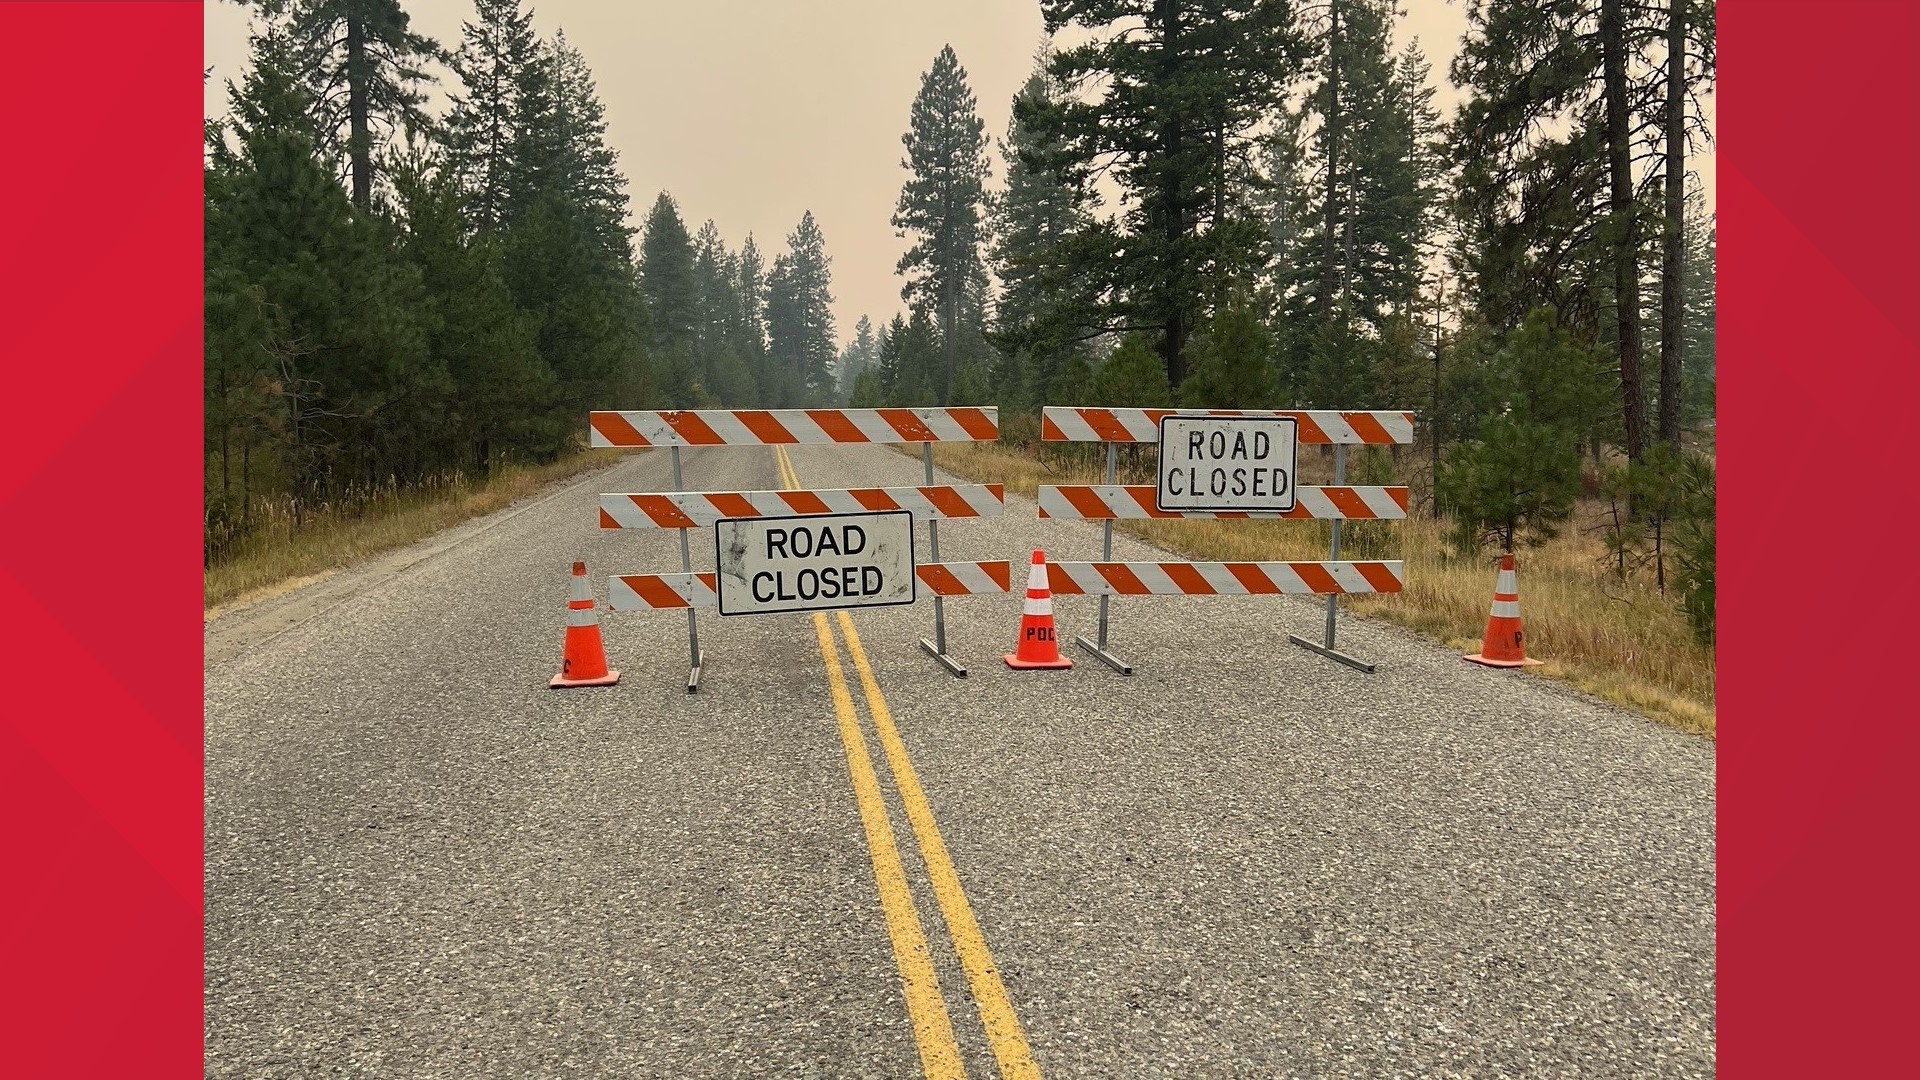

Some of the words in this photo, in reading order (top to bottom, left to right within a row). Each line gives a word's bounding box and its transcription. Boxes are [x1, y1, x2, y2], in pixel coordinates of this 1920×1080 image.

[1188, 431, 1270, 460] ROAD
[1168, 467, 1288, 497] CLOSED
[766, 525, 866, 559] ROAD
[752, 566, 883, 603] CLOSED
